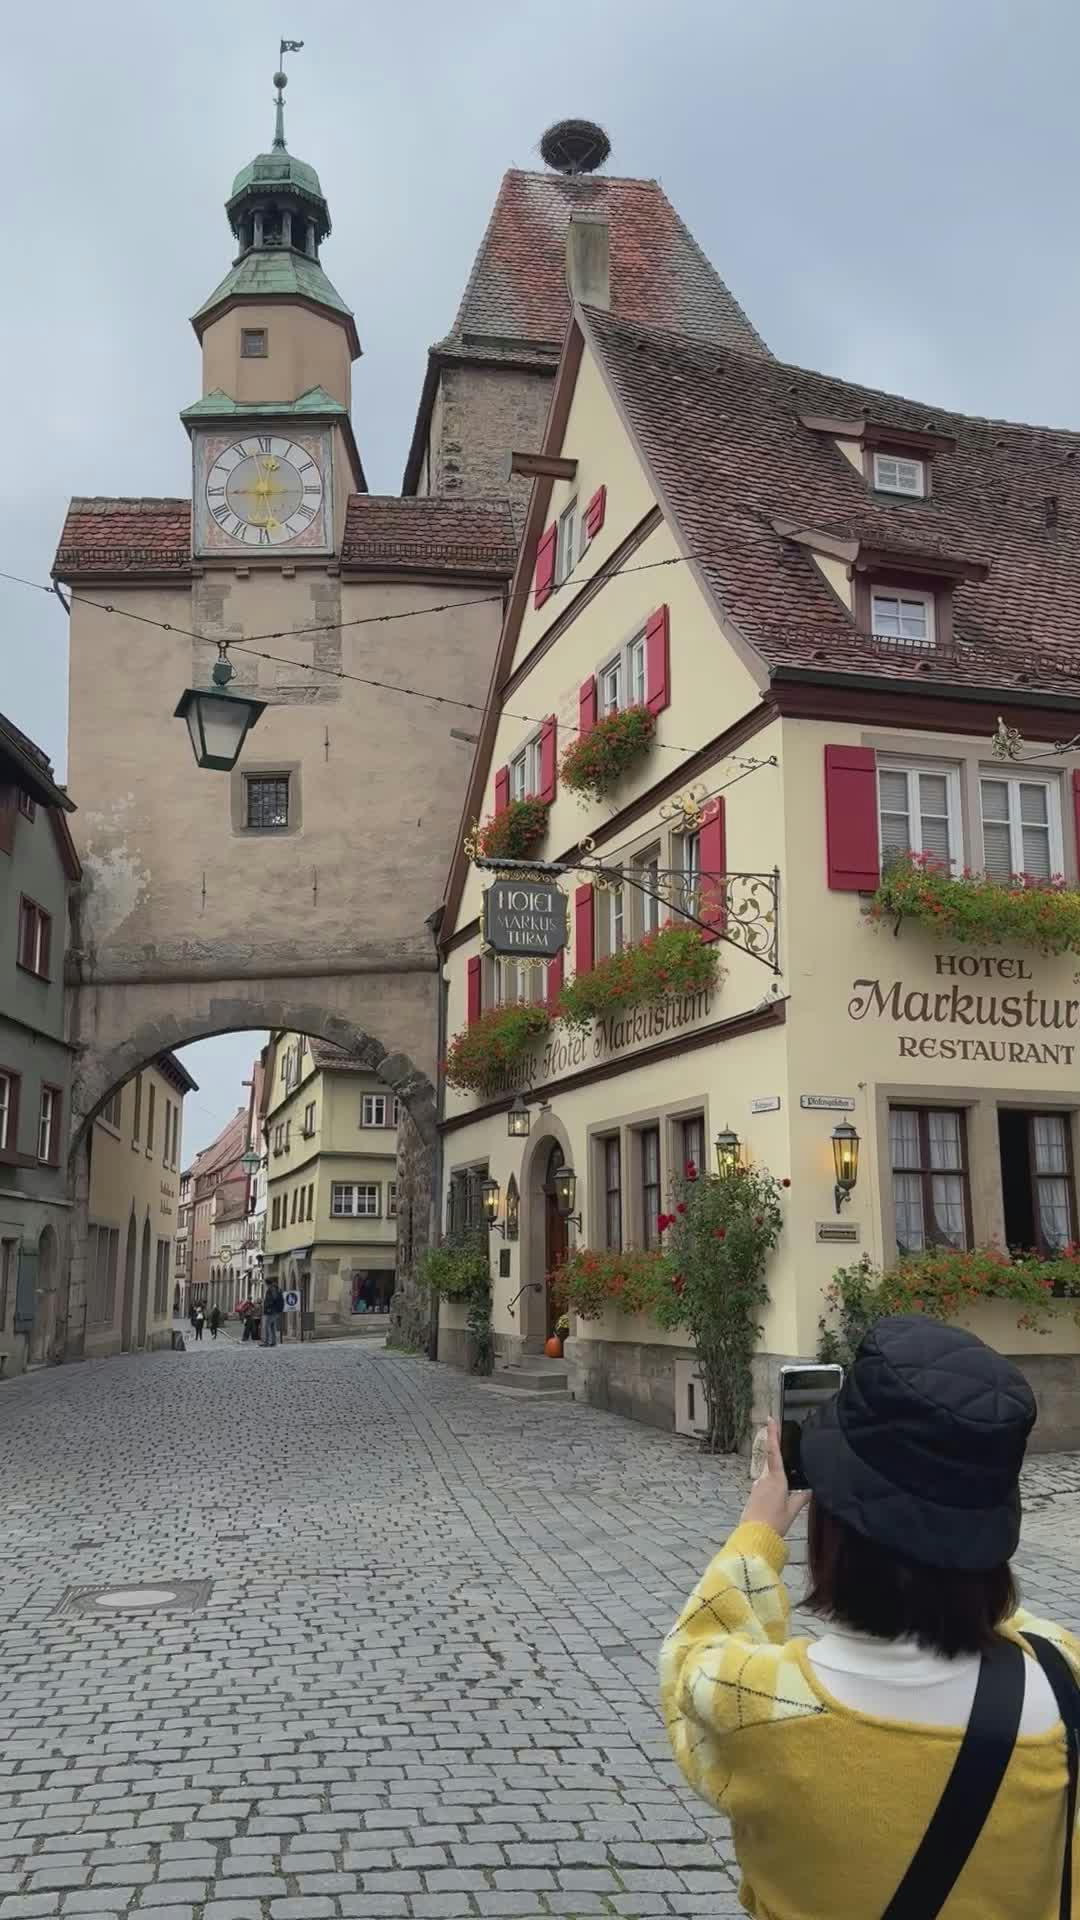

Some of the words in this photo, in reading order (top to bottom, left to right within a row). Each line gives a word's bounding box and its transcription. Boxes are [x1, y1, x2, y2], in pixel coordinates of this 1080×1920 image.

[498, 890, 553, 912] HOTEL
[497, 914, 557, 931] MARKUS
[506, 930, 549, 946] TURM
[934, 954, 1033, 980] HOTEL
[848, 978, 1080, 1029] Markustur
[543, 1034, 588, 1079] Hotel
[593, 988, 711, 1059] Markusturm
[898, 1036, 1075, 1065] RESTAURANT
